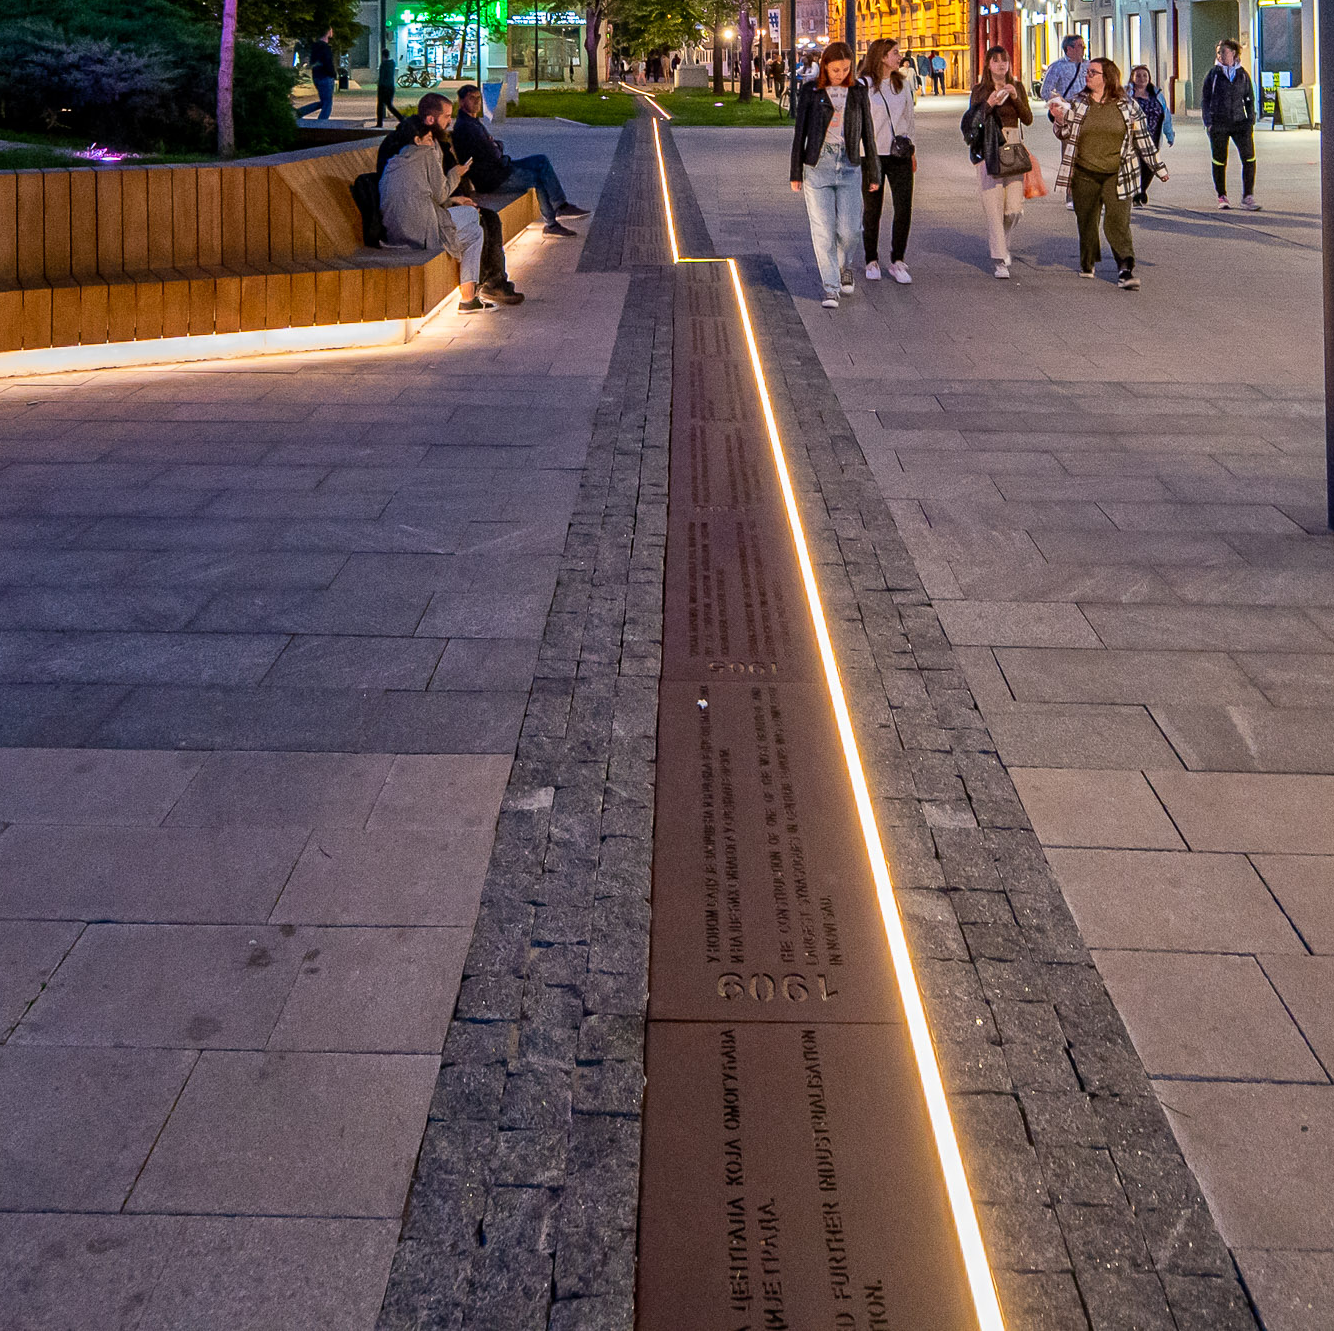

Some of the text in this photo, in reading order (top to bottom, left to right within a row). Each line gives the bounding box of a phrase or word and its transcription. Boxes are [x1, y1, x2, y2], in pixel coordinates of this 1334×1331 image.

[764, 808, 776, 826] ONE
[767, 832, 778, 845] OF
[769, 852, 791, 932] CONSTRUCTION
[779, 941, 794, 962] THE
[798, 910, 819, 965] LARGEST
[823, 922, 840, 950] NOVI
[828, 954, 843, 965] IN
[717, 972, 839, 1003] 1909
[722, 1028, 738, 1130] ОМОГУЋАВА
[801, 1029, 836, 1191] INDUSTRIALISATION
[726, 1138, 741, 1185] КОЈА
[728, 1197, 752, 1310] ЦЕНТРАЛА
[757, 1197, 778, 1274] ГРАДА.
[823, 1202, 851, 1299] FURTHER
